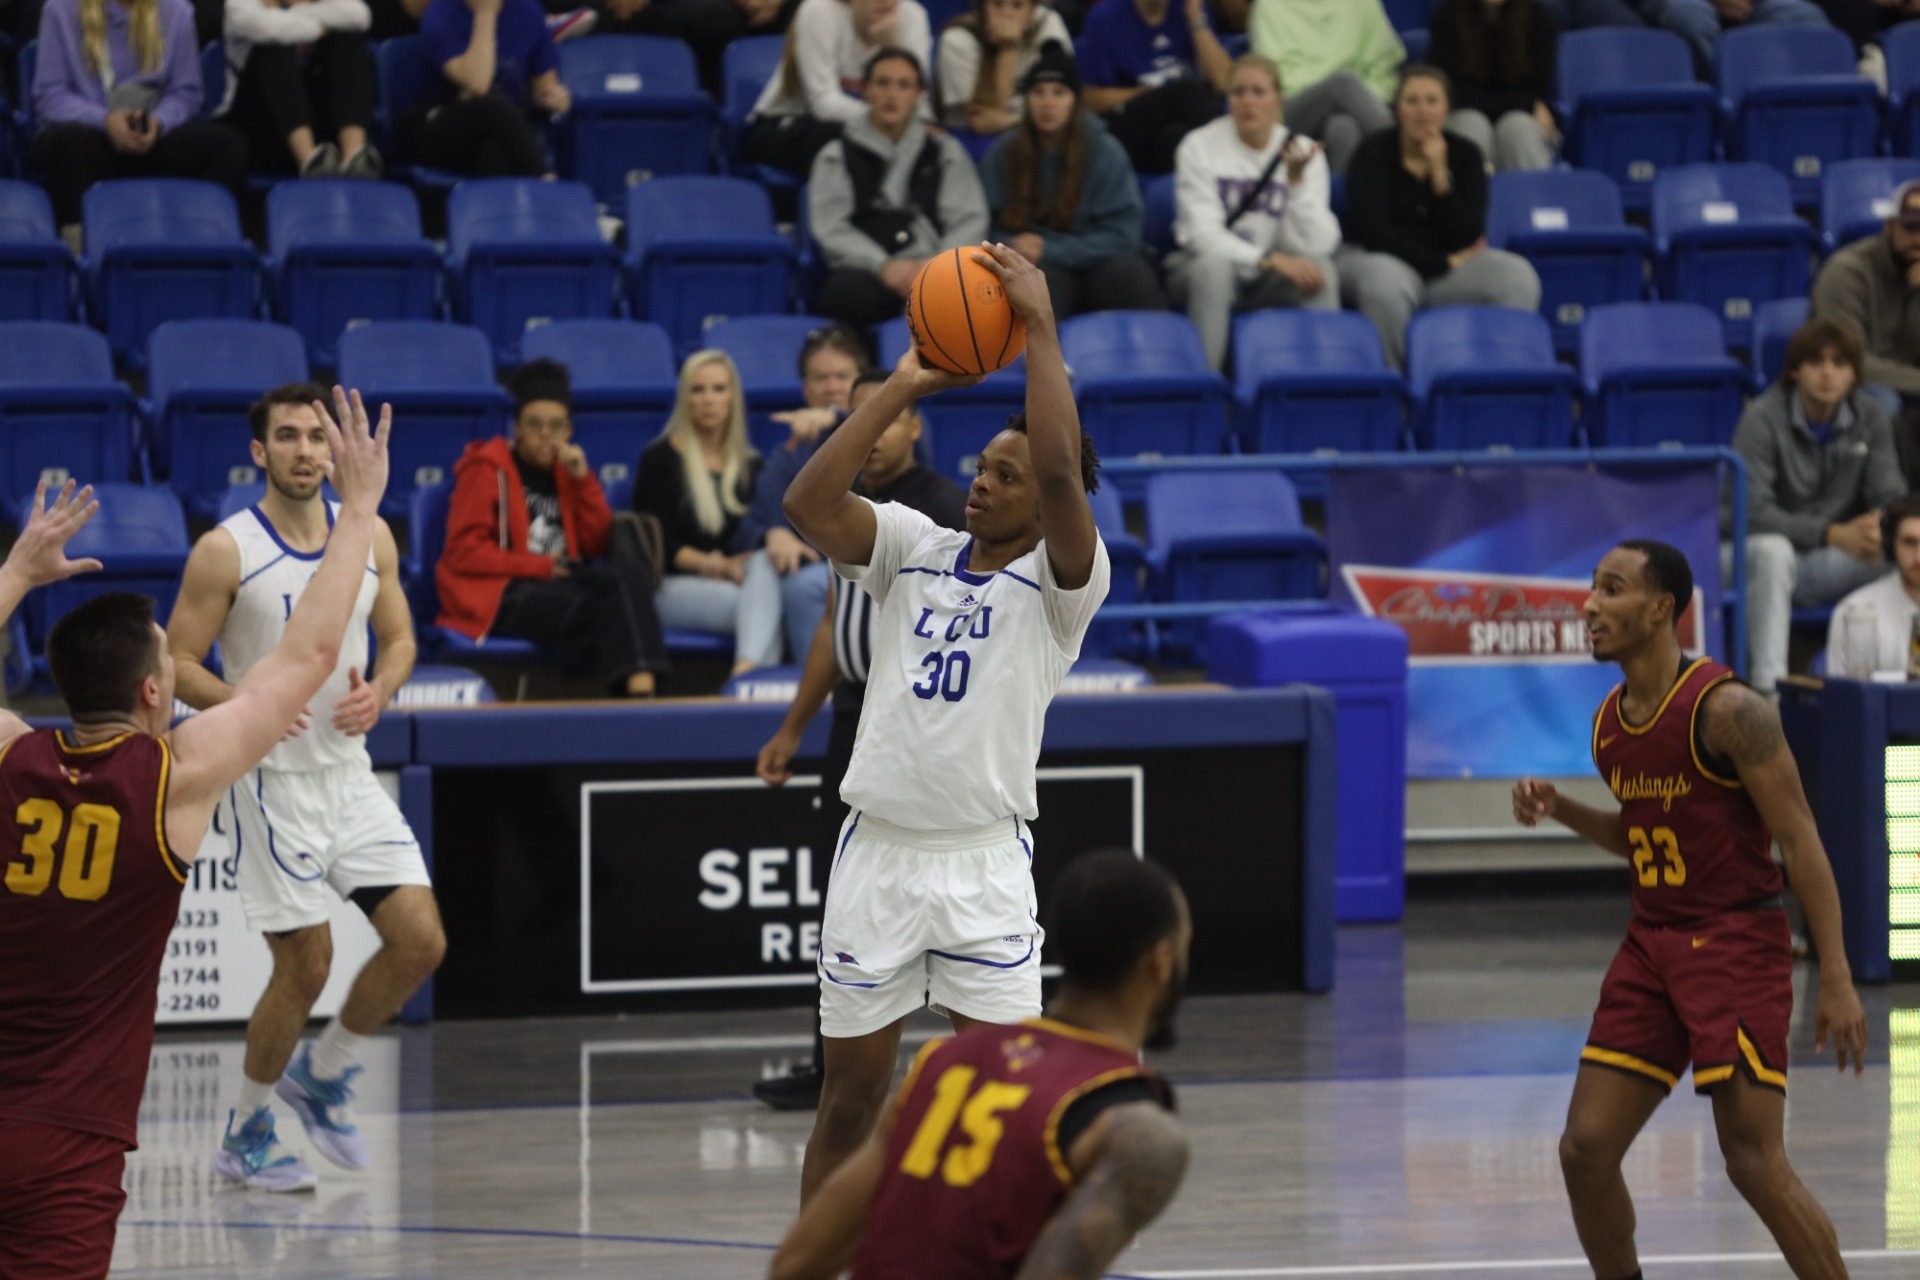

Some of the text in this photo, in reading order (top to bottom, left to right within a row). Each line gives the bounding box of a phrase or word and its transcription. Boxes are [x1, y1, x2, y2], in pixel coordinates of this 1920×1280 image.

[914, 606, 992, 642] LCU
[1469, 620, 1555, 655] SPORTS
[913, 650, 971, 702] 30
[1610, 765, 1691, 813] Mustangs
[4, 797, 121, 901] 30
[1628, 826, 1686, 888] 23
[698, 847, 820, 910] SEL
[902, 1064, 1031, 1187] 15
